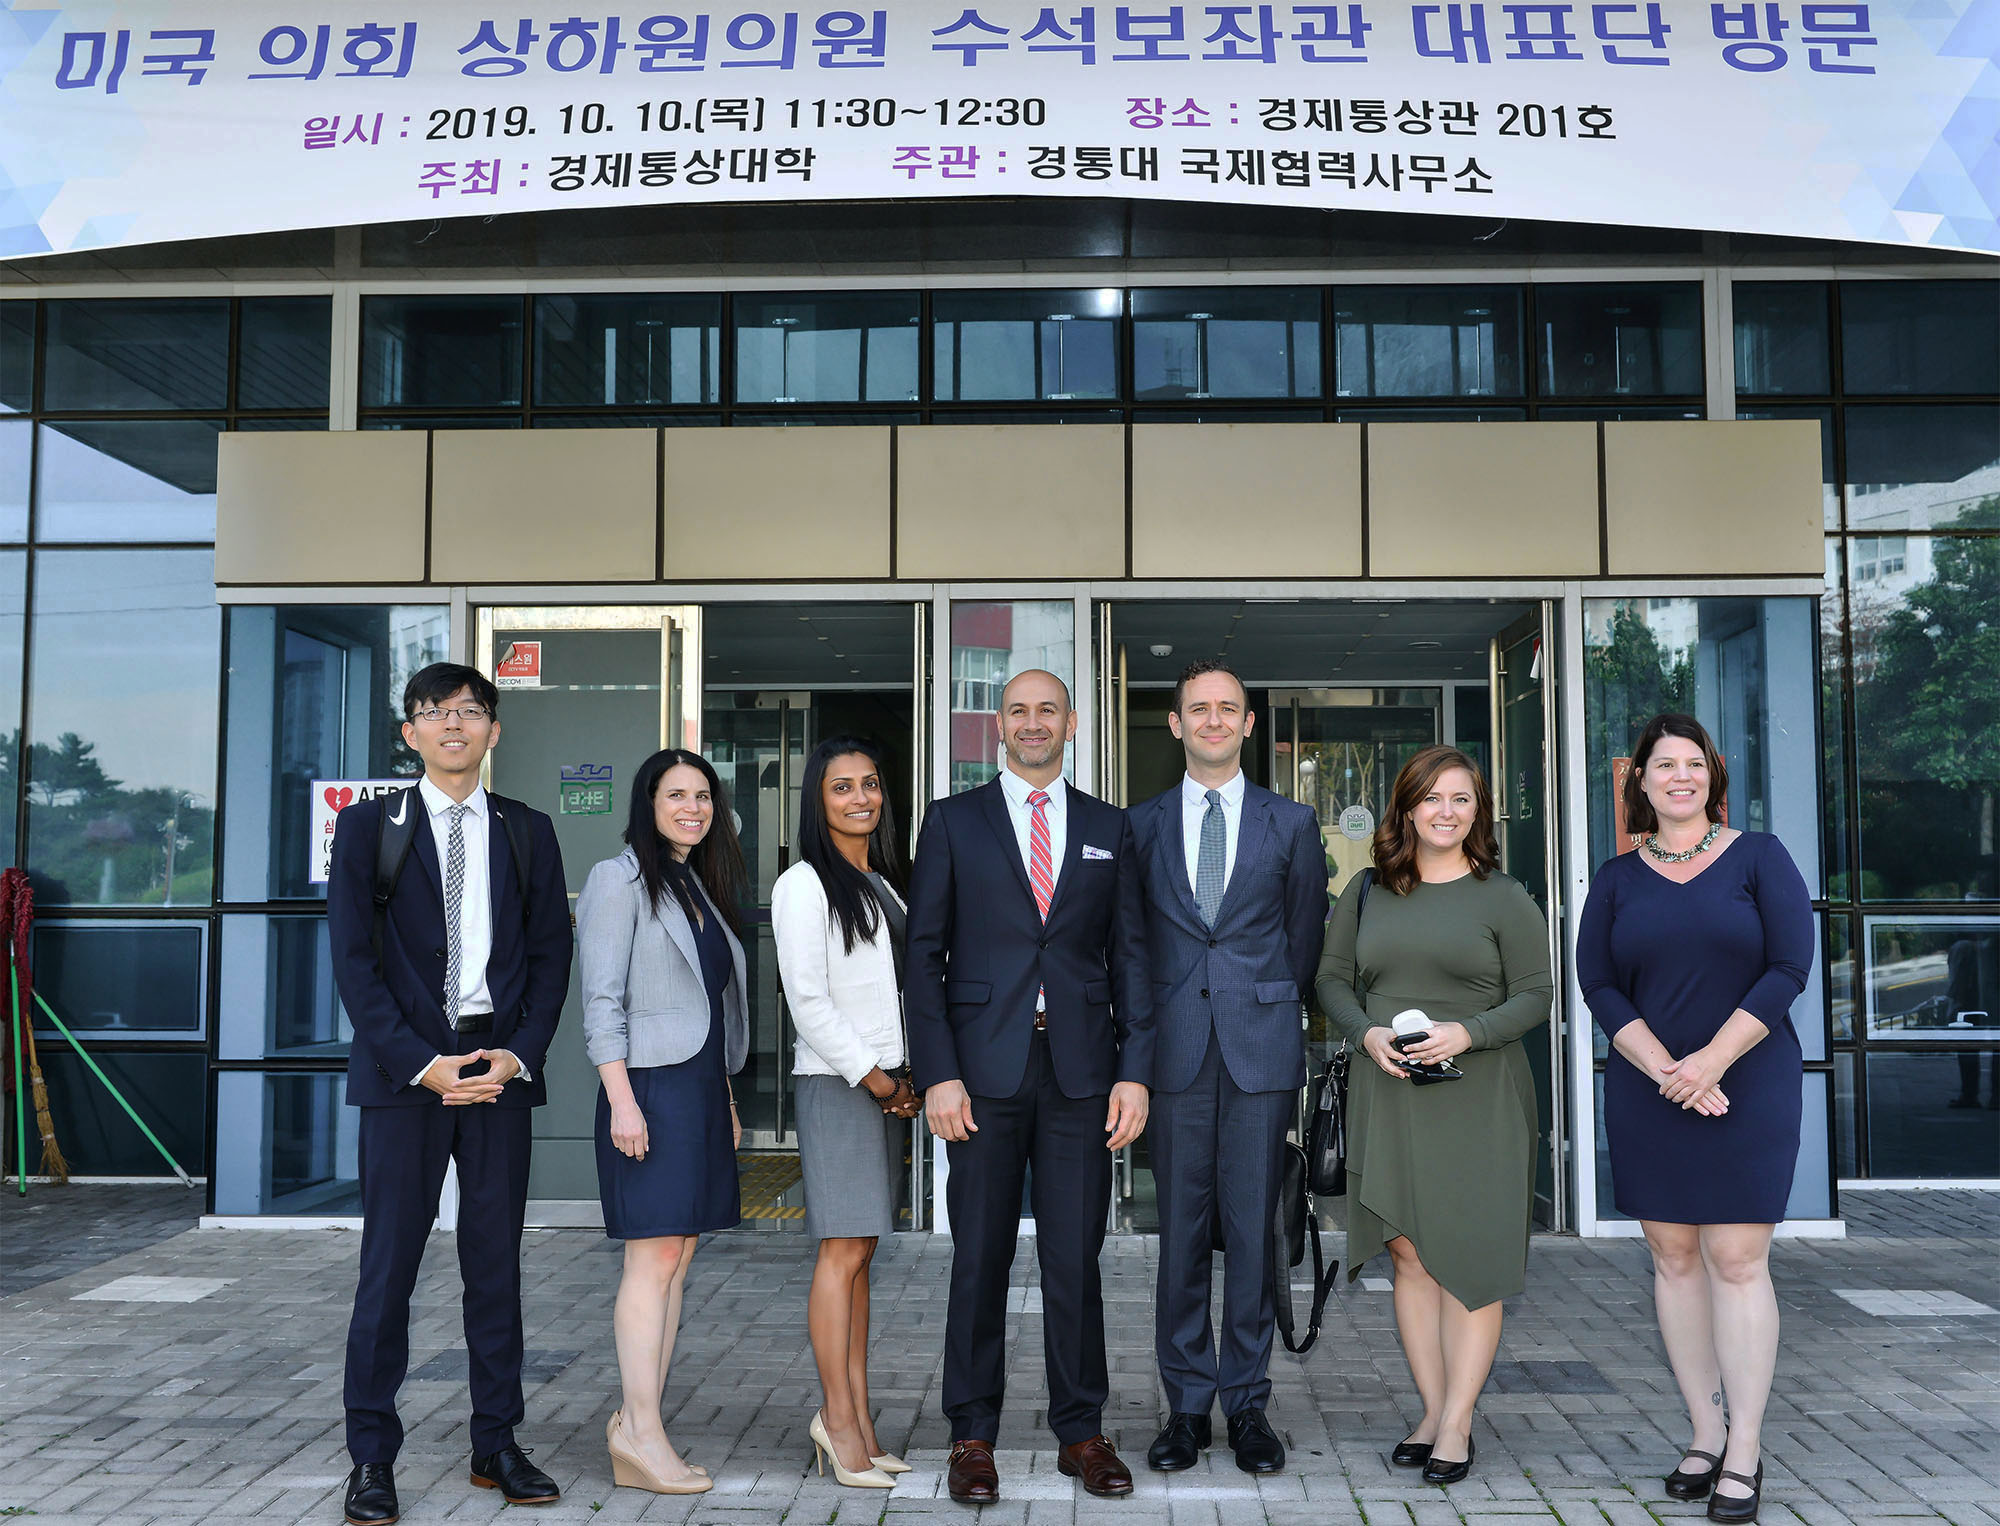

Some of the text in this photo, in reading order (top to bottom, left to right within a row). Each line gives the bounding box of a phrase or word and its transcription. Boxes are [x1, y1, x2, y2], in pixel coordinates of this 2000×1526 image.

[56, 3, 1877, 94] 미국 의회 상하원의원 수석보좌관 대표단 방문
[304, 113, 383, 149] 일시
[426, 106, 535, 140] 2019.
[560, 104, 613, 134] 10.
[786, 99, 1045, 128] 11:30~12:30
[1127, 98, 1210, 128] 장소
[1259, 99, 1479, 135] 경제통상관
[1497, 104, 1616, 139] 201호
[419, 159, 500, 196] 주최
[549, 148, 816, 191] 경제통상대학
[893, 146, 980, 179] 주관
[1028, 146, 1158, 181] 경통대
[1181, 149, 1493, 193] 국제협력사무소
